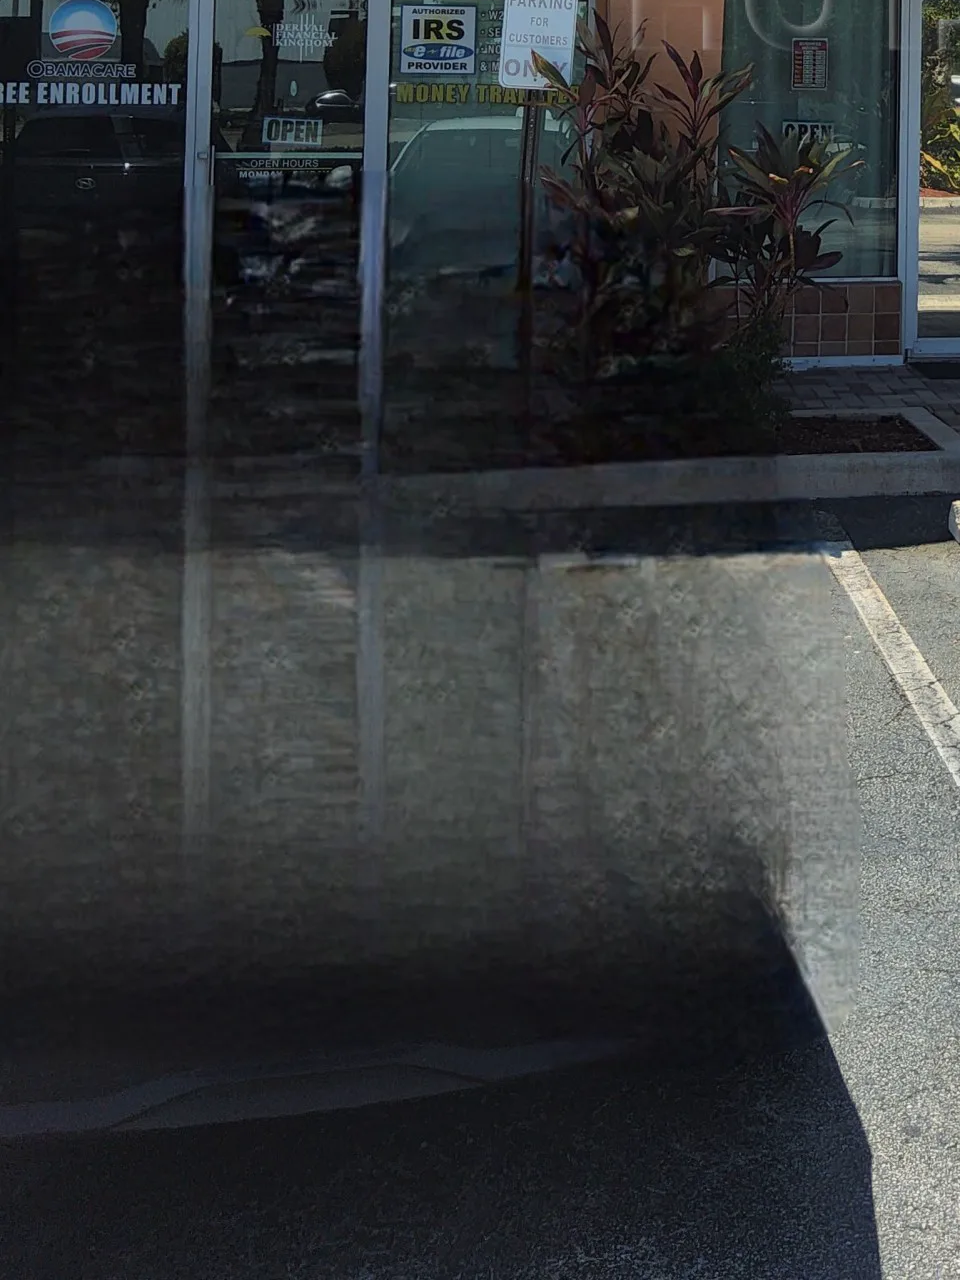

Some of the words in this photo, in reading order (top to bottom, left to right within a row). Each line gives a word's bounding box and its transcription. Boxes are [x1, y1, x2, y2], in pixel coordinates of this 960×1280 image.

[275, 23, 325, 32] DERIVAL
[530, 16, 549, 27] FOR
[275, 31, 338, 40] FINANCIAL
[413, 19, 465, 40] IRS
[275, 39, 333, 47] KINGDOM
[509, 33, 568, 46] CUSTOMERS
[27, 59, 136, 78] OBAMACARE
[407, 61, 467, 70] PROVIDER
[505, 58, 567, 77] ONY
[37, 82, 181, 105] ENROLLMENT
[396, 83, 469, 104] MONEY
[266, 118, 319, 143] OPEN
[250, 159, 279, 168] OPEN
[282, 159, 319, 168] HOURS
